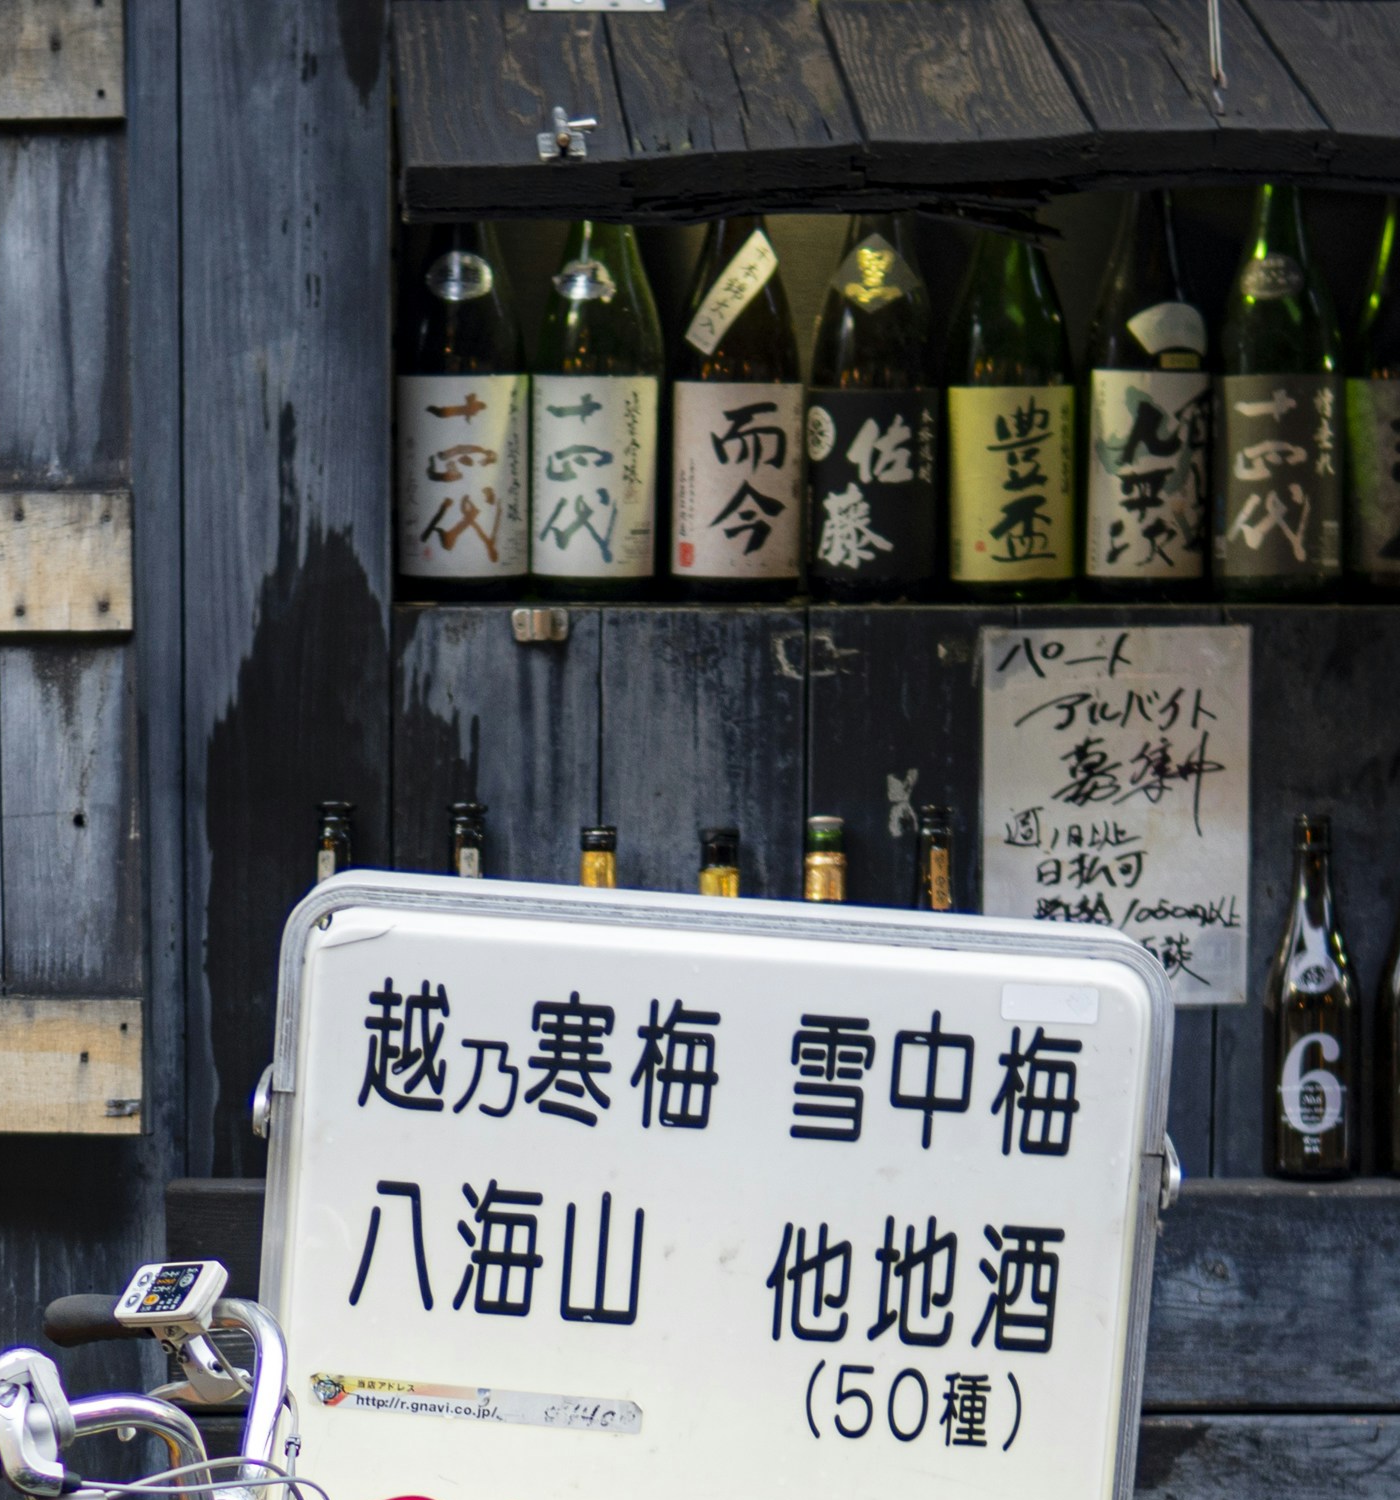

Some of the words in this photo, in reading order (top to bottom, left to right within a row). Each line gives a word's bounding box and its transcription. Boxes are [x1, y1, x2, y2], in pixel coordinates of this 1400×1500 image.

[421, 393, 502, 563] 十四代
[539, 393, 617, 563] 十四代
[709, 402, 787, 556] 而今
[817, 413, 914, 570] 佐藤
[1227, 389, 1311, 562] 十四代
[996, 632, 1132, 678] パート
[1014, 687, 1218, 731] アルバイト
[1051, 730, 1225, 837] 募集中
[1036, 850, 1148, 889] 日払可
[357, 976, 721, 1129] 越乃寒梅
[789, 1010, 1082, 1157] 雪中梅
[1281, 1032, 1341, 1135] 6
[349, 1179, 645, 1325] 八海山
[766, 1215, 1065, 1353] 他地酒
[355, 1393, 498, 1419] http://r.gnavi.co.jp/
[357, 1378, 416, 1392] 当店アドレス
[805, 1359, 1021, 1451] (50種)
